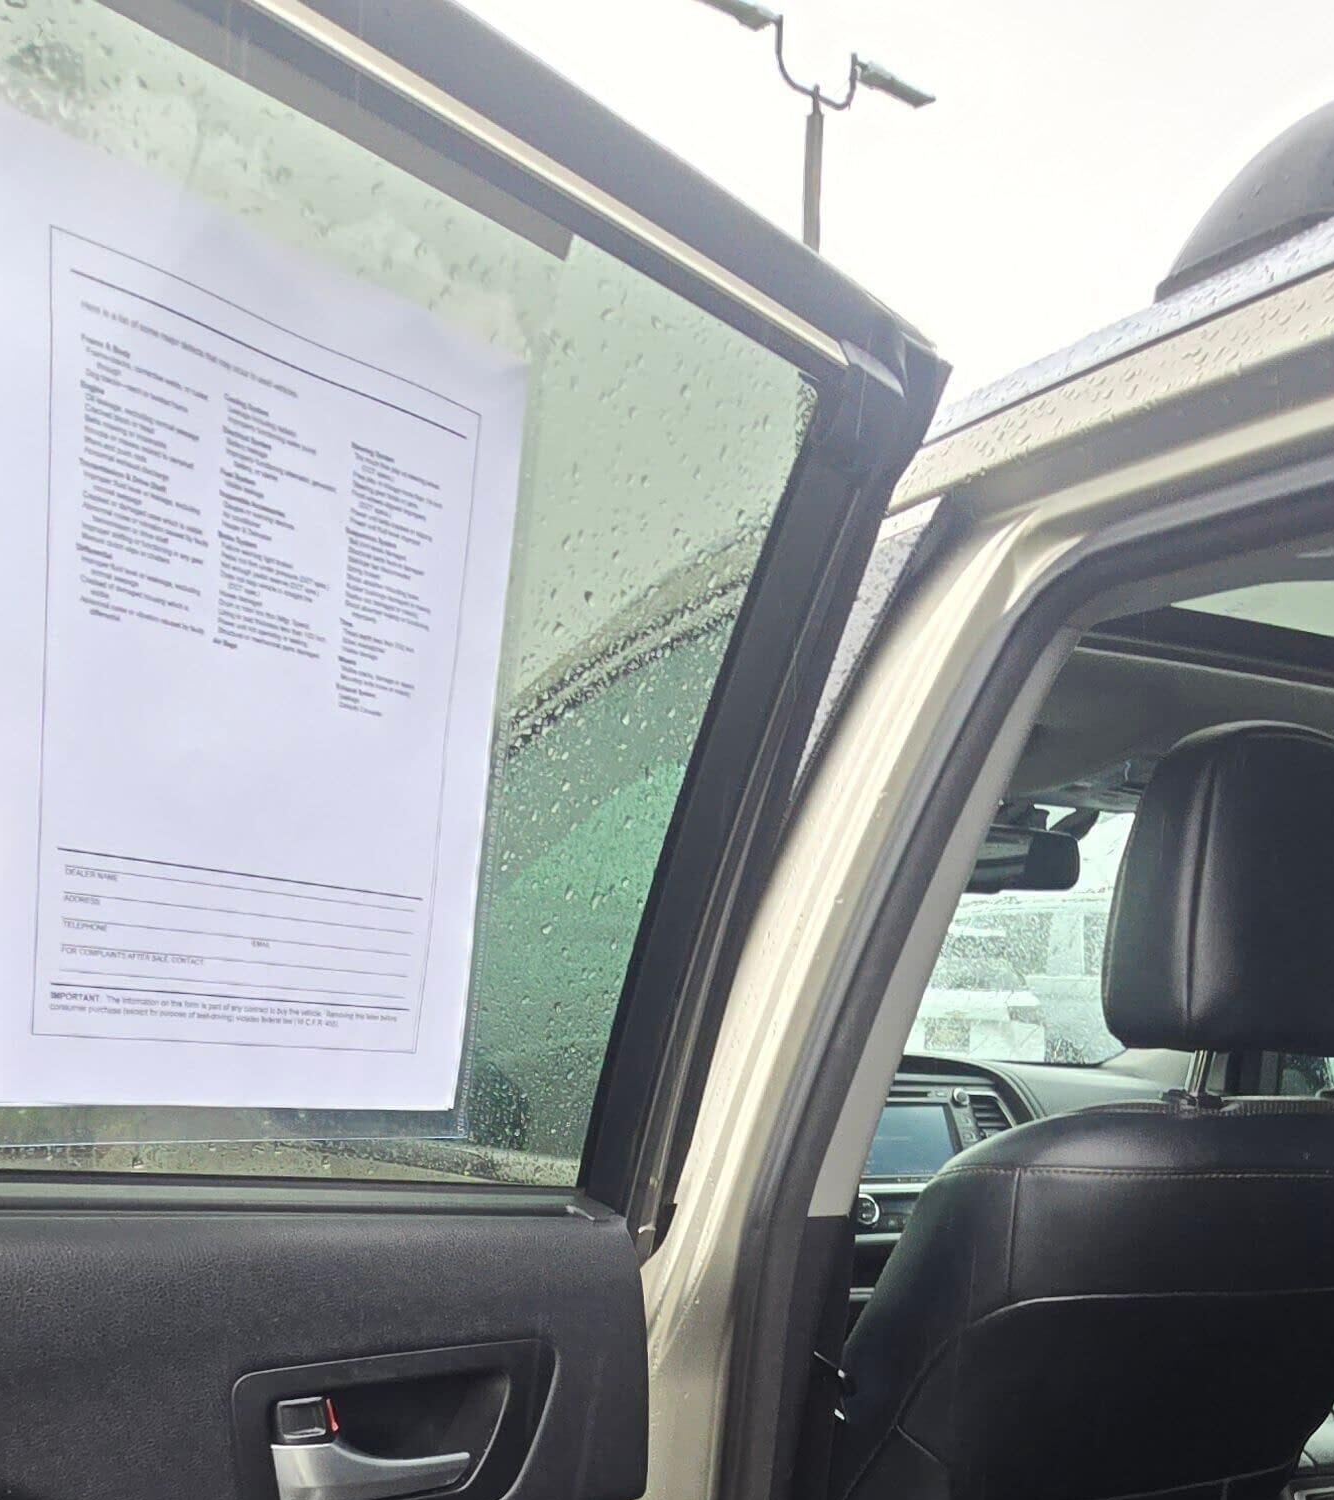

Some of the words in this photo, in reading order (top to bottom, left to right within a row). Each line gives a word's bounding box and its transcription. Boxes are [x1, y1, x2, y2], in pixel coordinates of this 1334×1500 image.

[65, 868, 95, 878] DEALER
[97, 872, 118, 881] NAME
[63, 920, 107, 932] TELEPHONE
[61, 945, 77, 955] FOR
